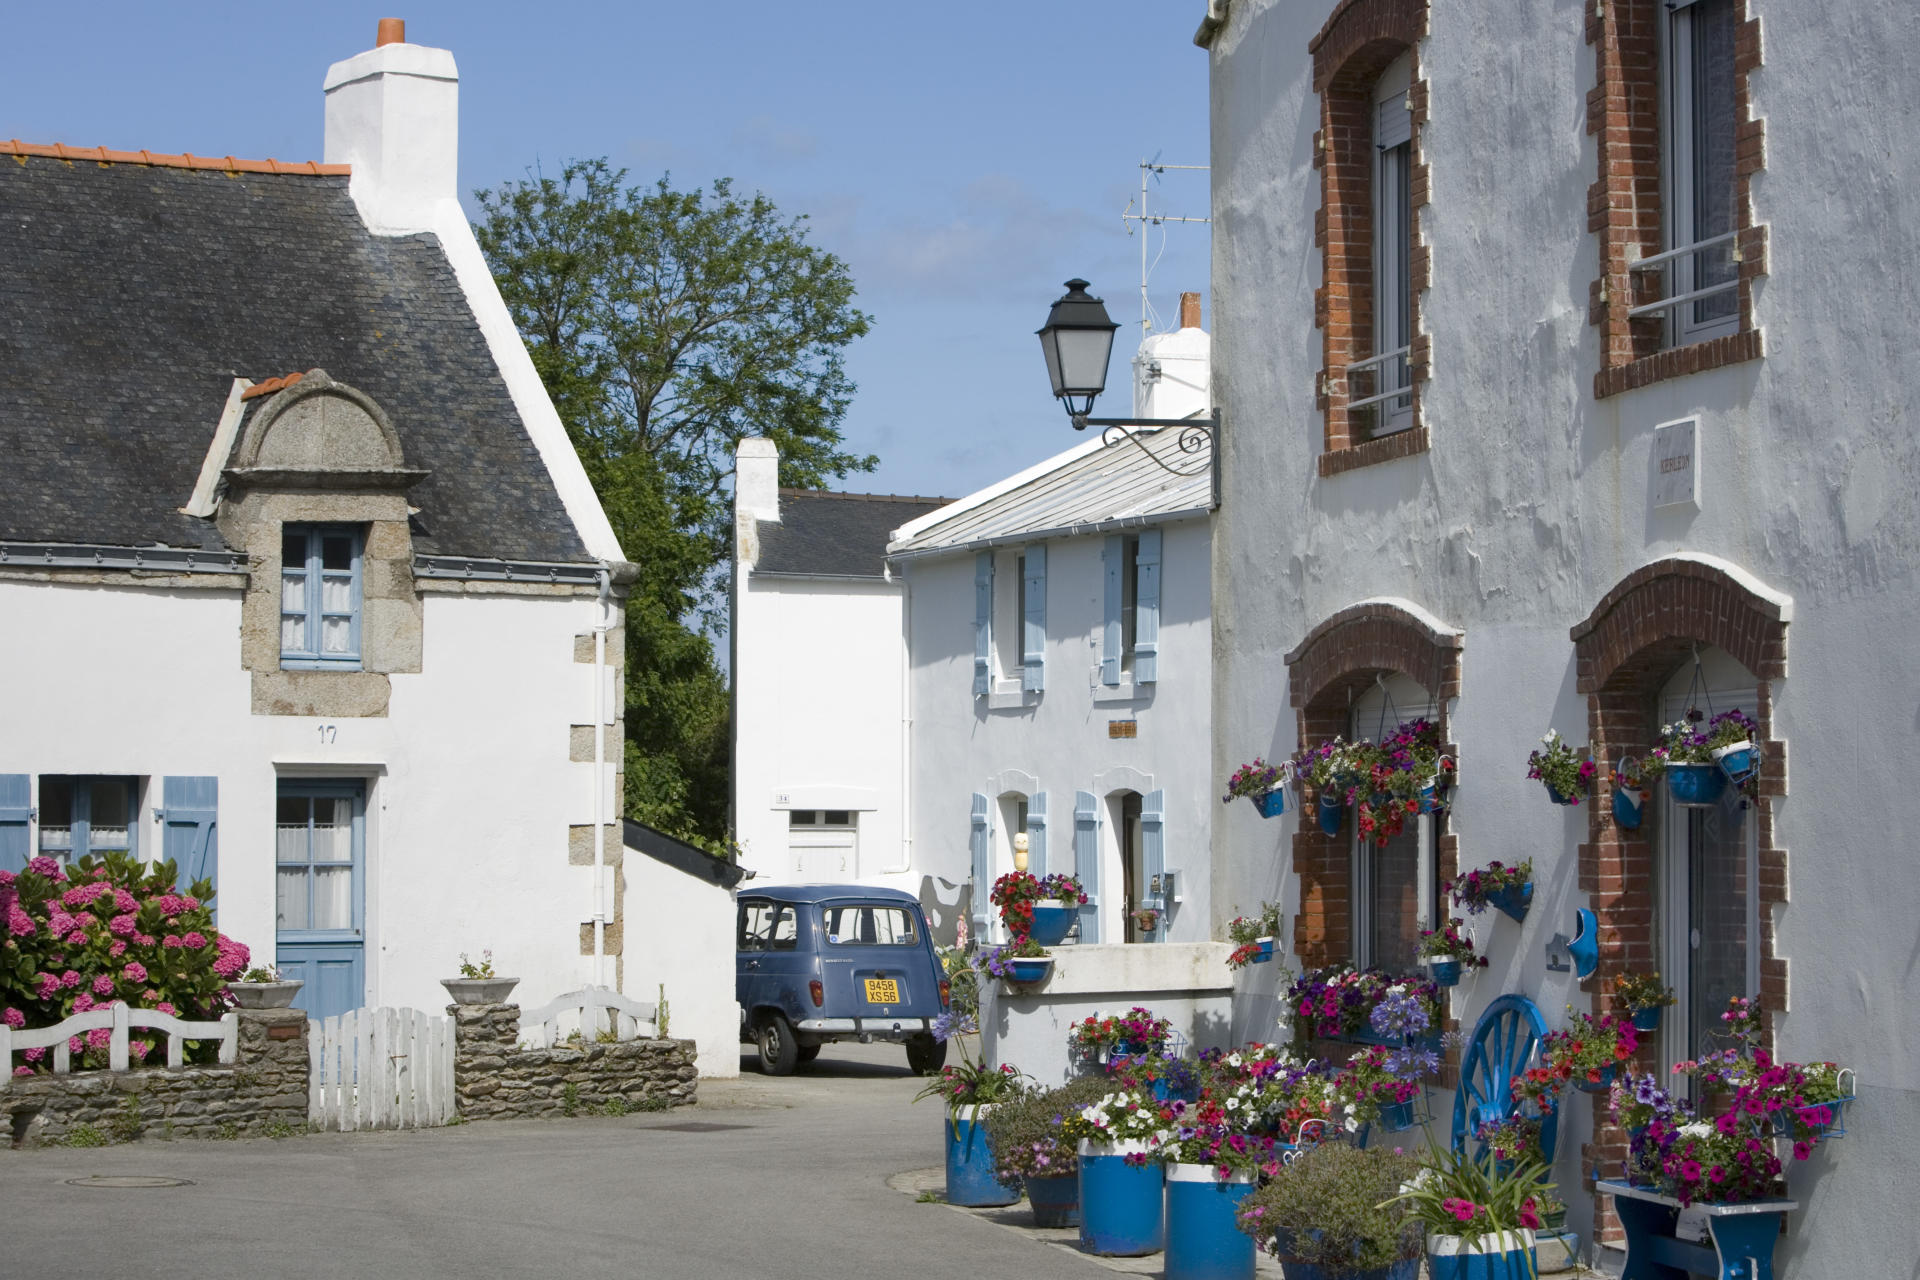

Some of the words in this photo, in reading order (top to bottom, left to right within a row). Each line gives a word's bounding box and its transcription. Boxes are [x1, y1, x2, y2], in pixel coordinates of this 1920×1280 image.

[318, 725, 336, 744] 17
[868, 980, 894, 991] 9458
[870, 991, 882, 1002] XS
[884, 991, 896, 1002] 56
